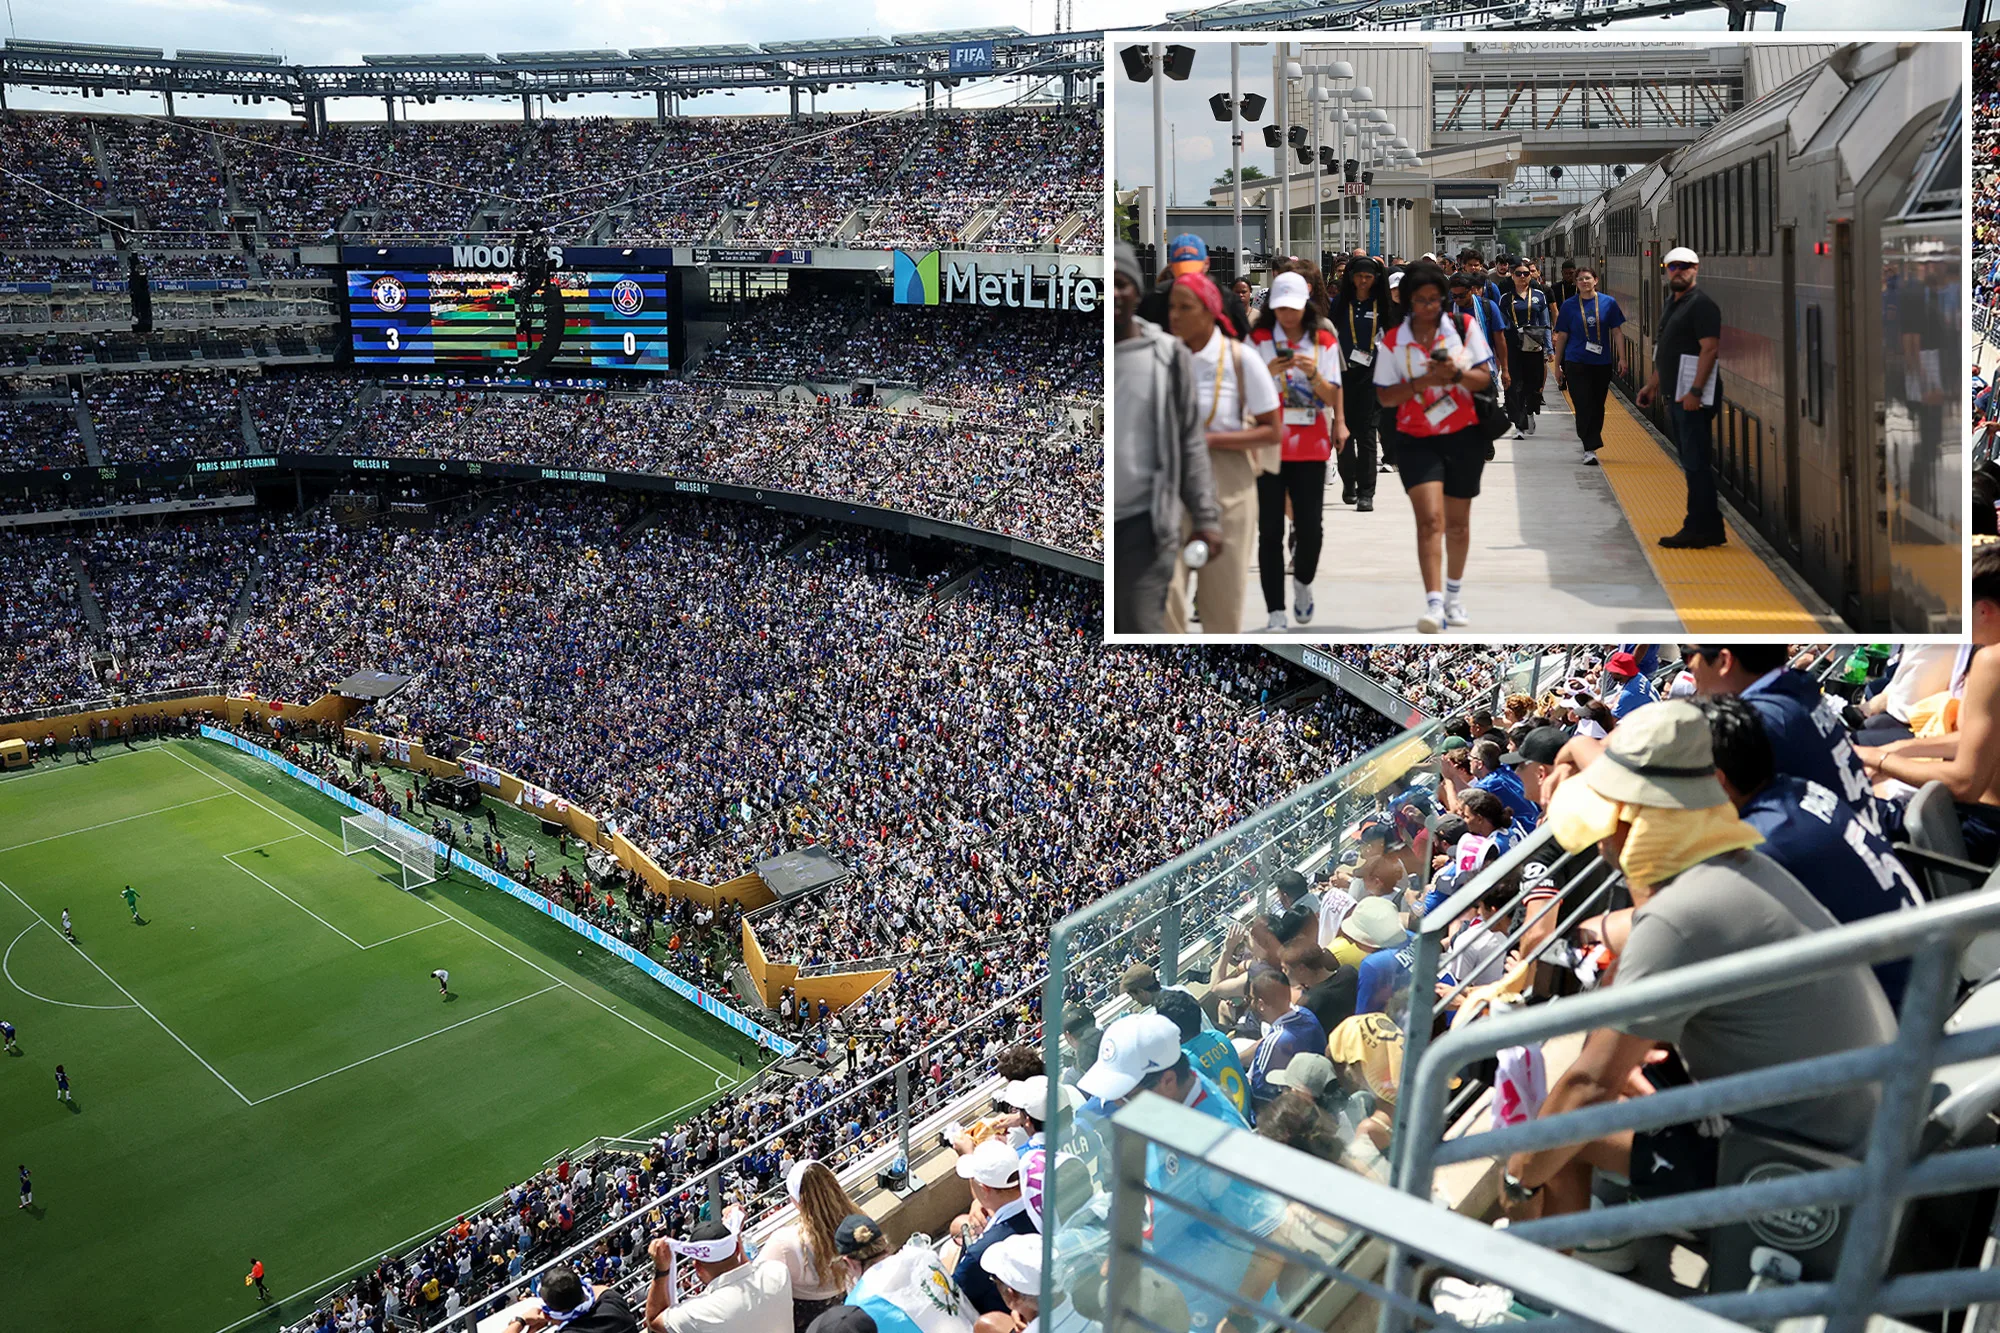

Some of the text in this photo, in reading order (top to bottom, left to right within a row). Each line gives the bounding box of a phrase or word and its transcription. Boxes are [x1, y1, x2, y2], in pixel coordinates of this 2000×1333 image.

[956, 48, 985, 62] FIFA
[1347, 184, 1363, 195] EXIT
[945, 261, 1097, 313] MetLife
[386, 328, 400, 350] 3
[623, 332, 636, 356] 0
[197, 458, 277, 472] PARIS SAINT-GERMAIN
[353, 459, 389, 469] CHELSEA FC
[541, 469, 606, 483] PARIS SAINT-GERMAIN
[674, 481, 709, 493] CHELSEA FC
[94, 509, 114, 517] LIGHT
[412, 506, 428, 514] 2025
[1302, 649, 1341, 681] CHELSEA FC
[240, 739, 267, 761] ULTRA
[268, 752, 288, 772] ZERO
[324, 780, 354, 811] ULTRA
[468, 861, 499, 886] ZERO
[505, 881, 635, 963] Michelob ULTRA ZERO
[649, 963, 694, 999] Michelob
[705, 1000, 755, 1039] ULTRA
[1199, 1041, 1229, 1068] ETO'O
[1220, 1066, 1245, 1113] 9
